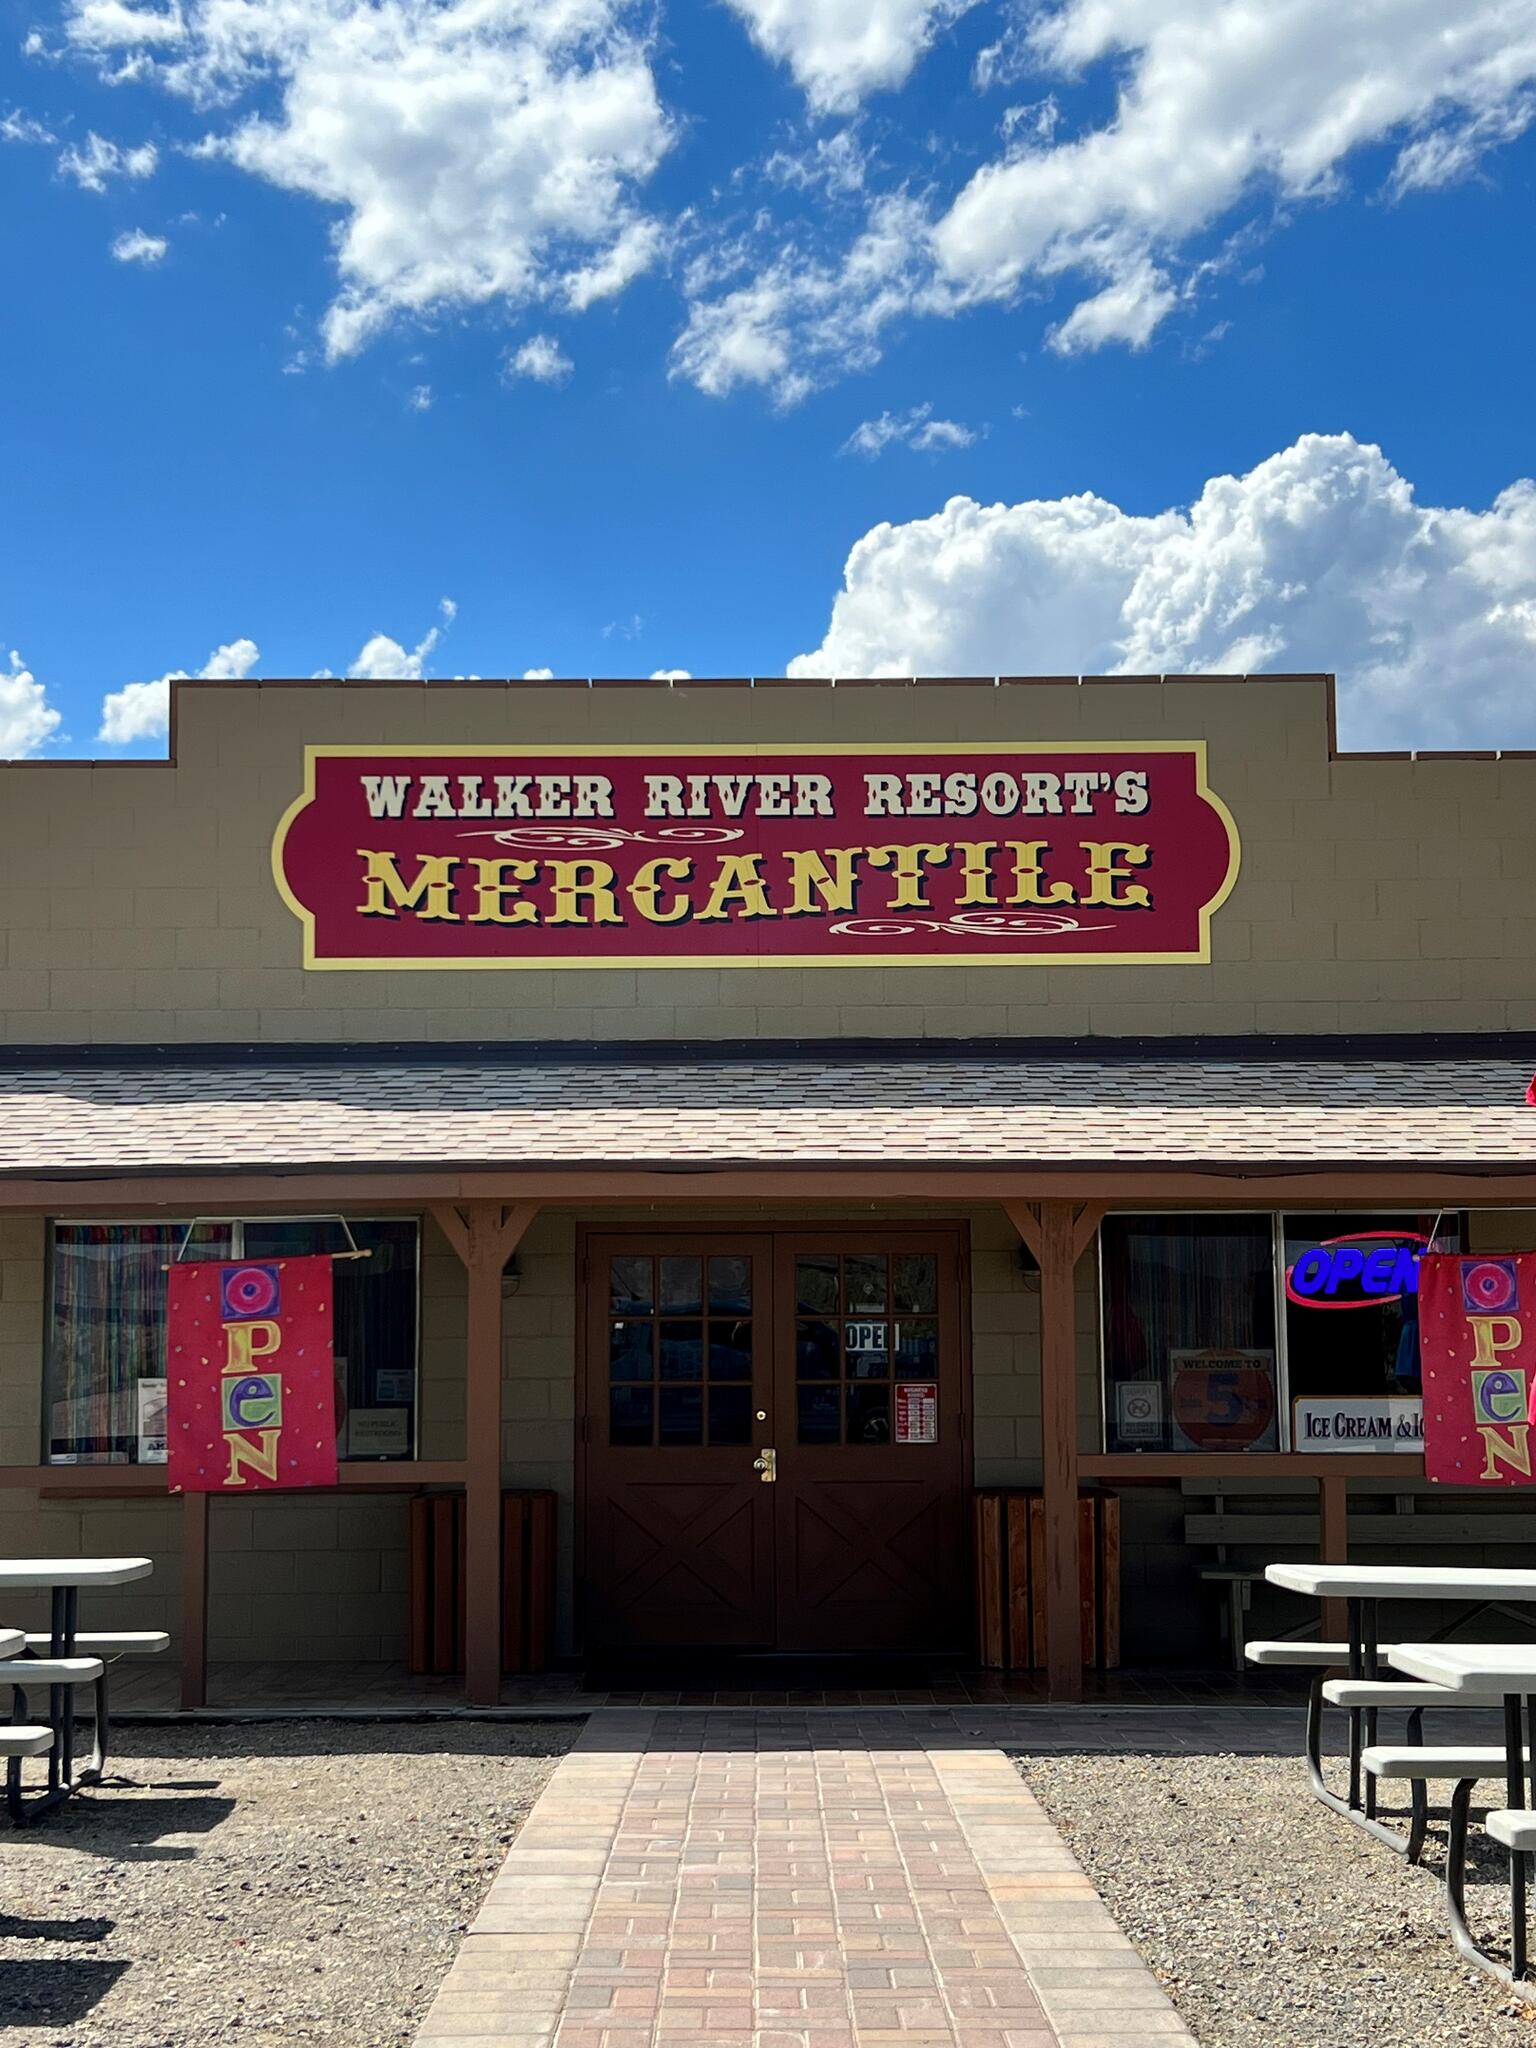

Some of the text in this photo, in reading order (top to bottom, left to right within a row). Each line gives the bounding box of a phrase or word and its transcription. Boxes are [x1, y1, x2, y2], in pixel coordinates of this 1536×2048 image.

[360, 771, 1151, 819] WALKER RIVER RESORT'S
[356, 840, 1152, 925] MERCANTILE
[1183, 1359, 1261, 1369] WELCOME TO
[1207, 1373, 1243, 1427] 5
[1396, 1414, 1412, 1438] &
